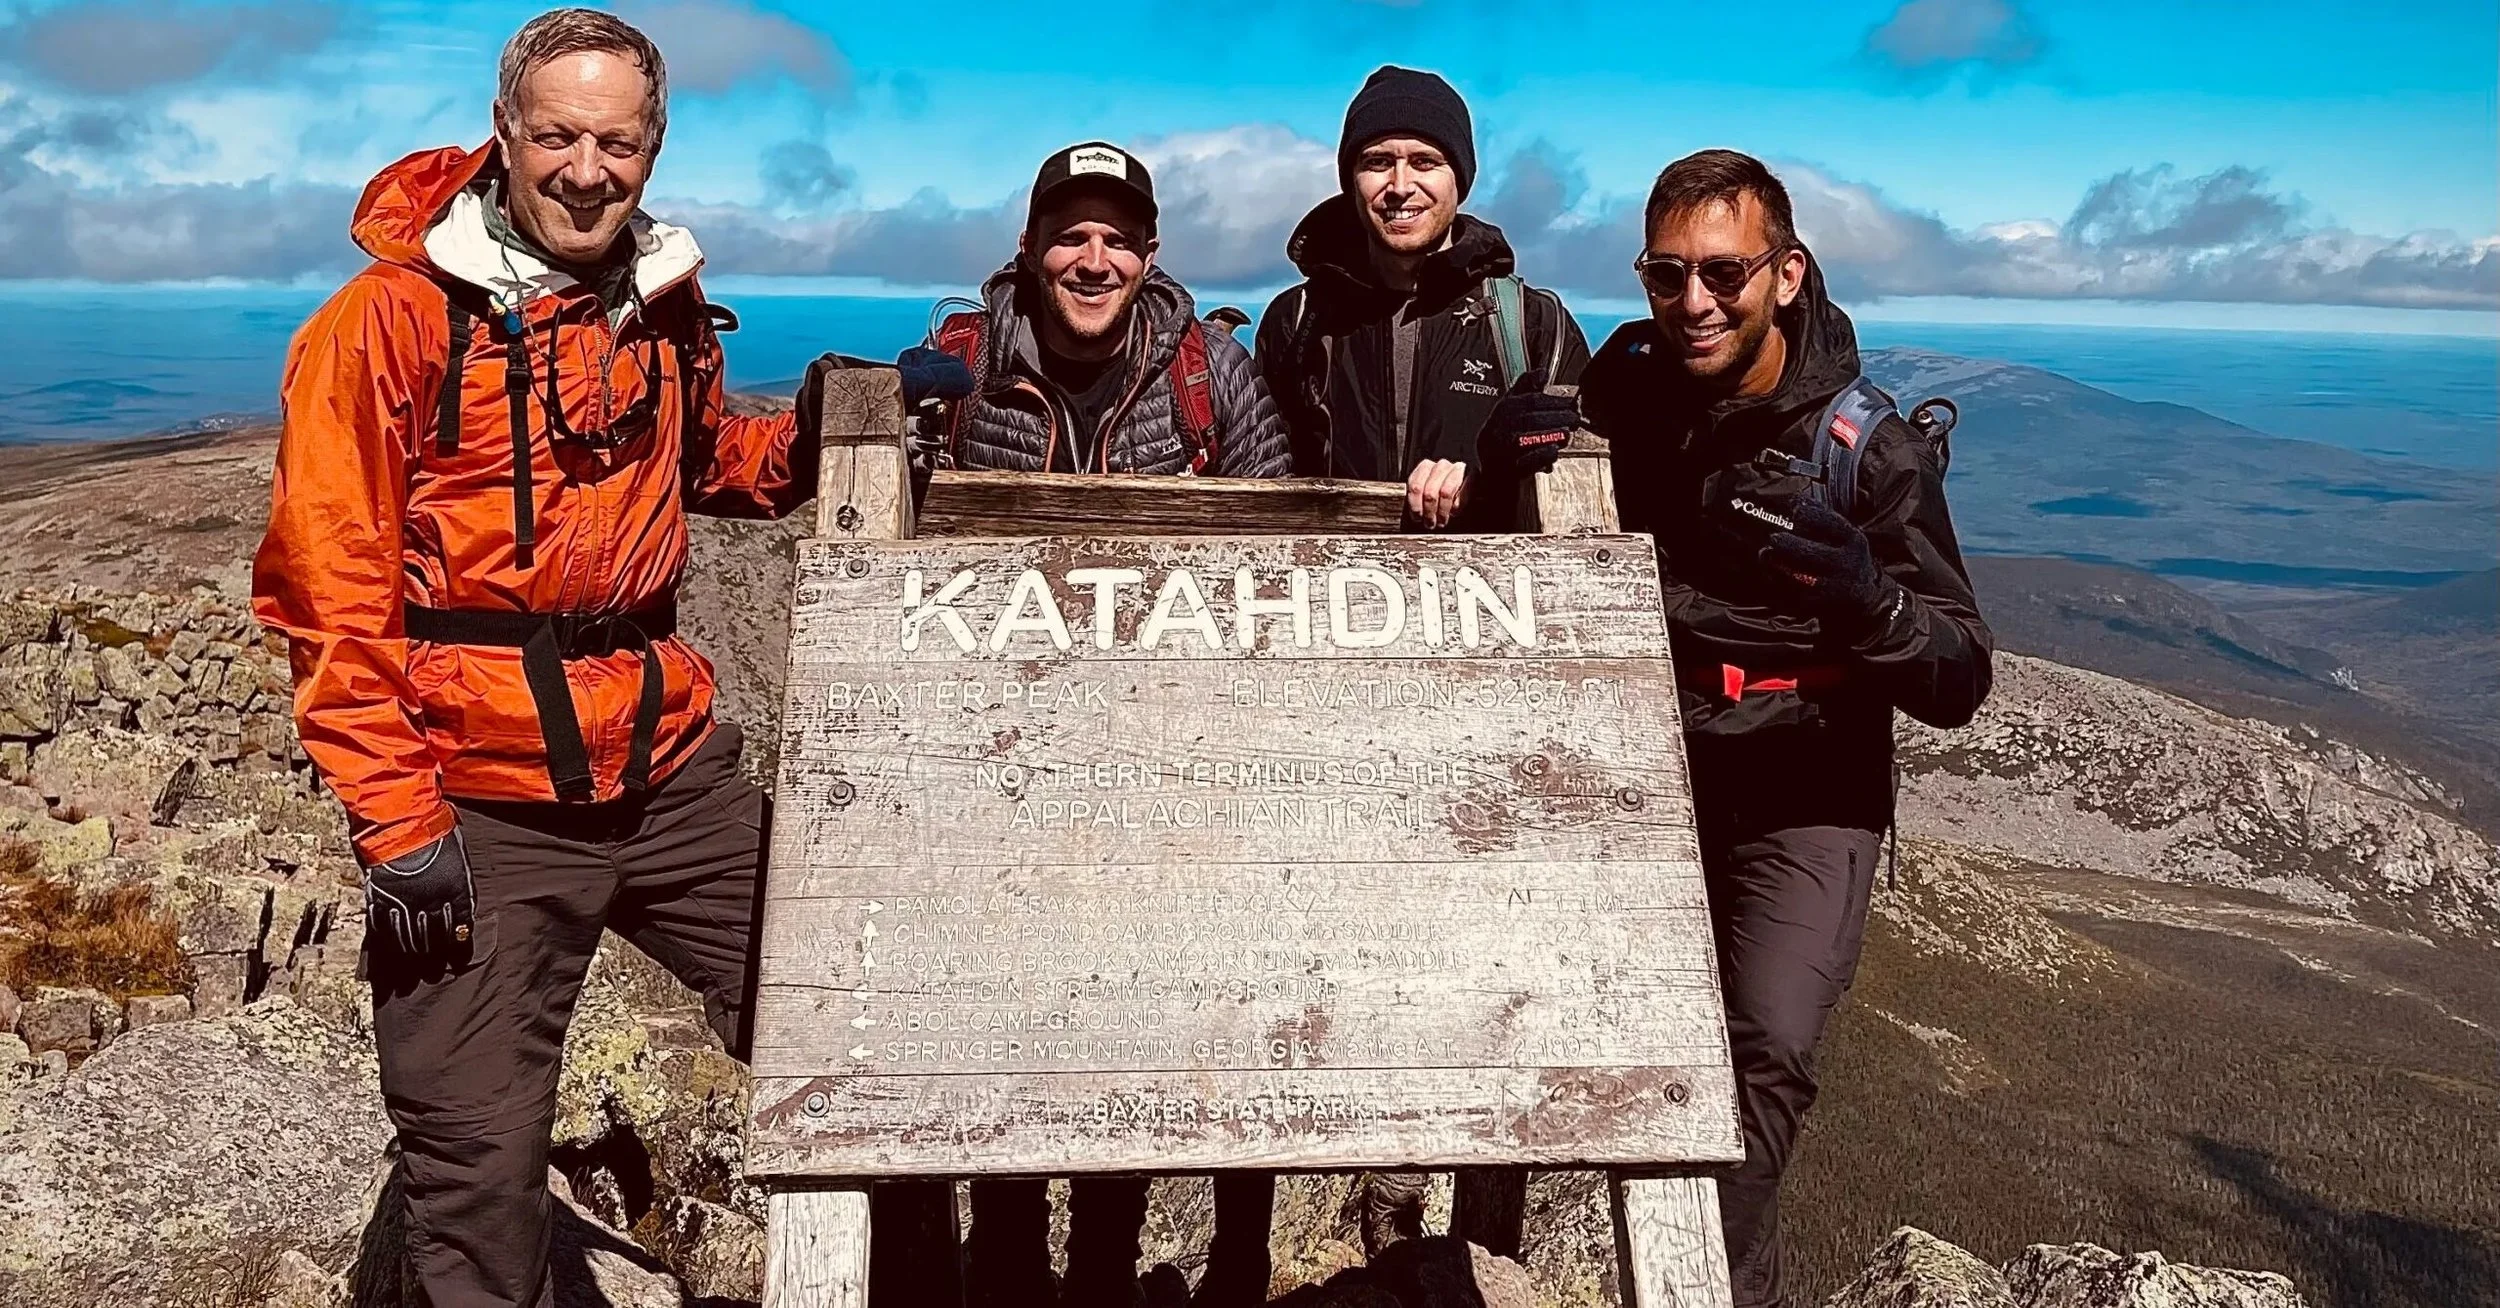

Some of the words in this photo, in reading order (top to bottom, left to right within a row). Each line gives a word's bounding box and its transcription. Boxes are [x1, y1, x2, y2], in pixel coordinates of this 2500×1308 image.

[1519, 435, 1540, 446] SOUTH
[1742, 501, 1795, 530] Columbia
[901, 564, 1538, 653] KATAHDIN
[827, 680, 987, 710] BAXTER
[1001, 680, 1109, 709] PEAK
[1232, 677, 1455, 708] ELEVATION
[1477, 678, 1567, 709] 5267
[1171, 760, 1345, 788] TERMINUS
[1352, 760, 1398, 787] OF
[1409, 761, 1472, 787] THE
[1008, 798, 1307, 829] APPALACHIAN
[1317, 797, 1438, 829] TRAIL
[894, 896, 1001, 916] PAMOLA
[1010, 895, 1079, 915] PEAK
[1129, 894, 1206, 914] KNIFE
[893, 923, 1016, 944] CHIMNEY
[1020, 922, 1095, 943] POND
[1102, 921, 1294, 943] CAMPGROUND
[1302, 921, 1336, 941] via
[1341, 919, 1446, 942] SADDLE
[891, 951, 1014, 973] ROARING
[1022, 951, 1117, 973] BROOK
[1125, 949, 1317, 973] CAMPGROUND
[1365, 949, 1470, 972] SADDLE
[889, 981, 1024, 1002] KATAHDIN
[1033, 979, 1141, 1001] STREAM
[1149, 978, 1342, 1001] CAMPGROUND
[886, 1010, 960, 1032] ABOL
[969, 1008, 1165, 1033] CAMPGROUND
[884, 1040, 1024, 1063] SPRINGER
[1033, 1038, 1183, 1063] MOUNTAIN,
[1191, 1036, 1316, 1060] GEORGIA
[1322, 1037, 1361, 1060] via
[1366, 1037, 1407, 1059] the
[1093, 1099, 1198, 1120] BAXTER
[1207, 1099, 1287, 1122] STATE
[1296, 1099, 1367, 1120] PARK
